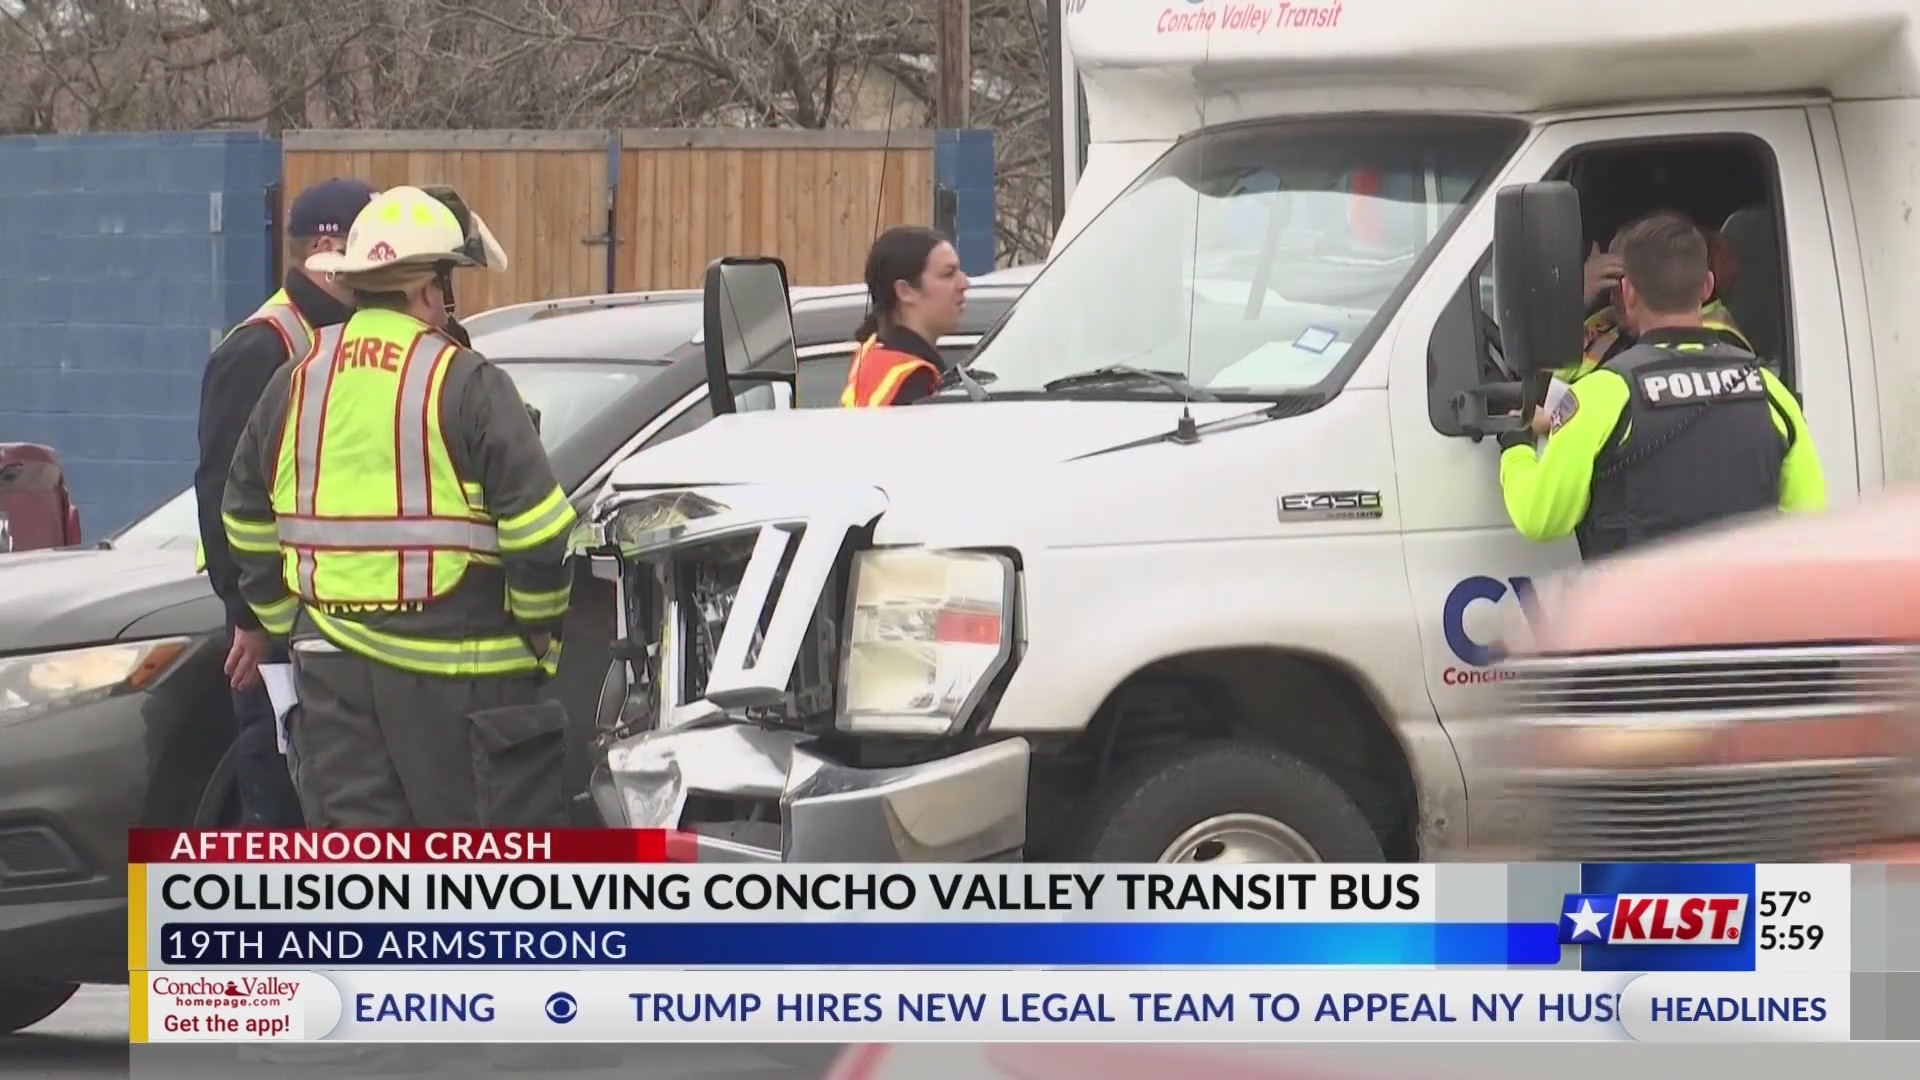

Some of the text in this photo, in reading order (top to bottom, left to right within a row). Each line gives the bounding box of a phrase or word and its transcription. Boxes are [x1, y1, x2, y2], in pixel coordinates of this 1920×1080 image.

[1157, 0, 1343, 35] Concho Valley Transit
[337, 337, 404, 373] FIRE
[1644, 367, 1763, 403] POLICE
